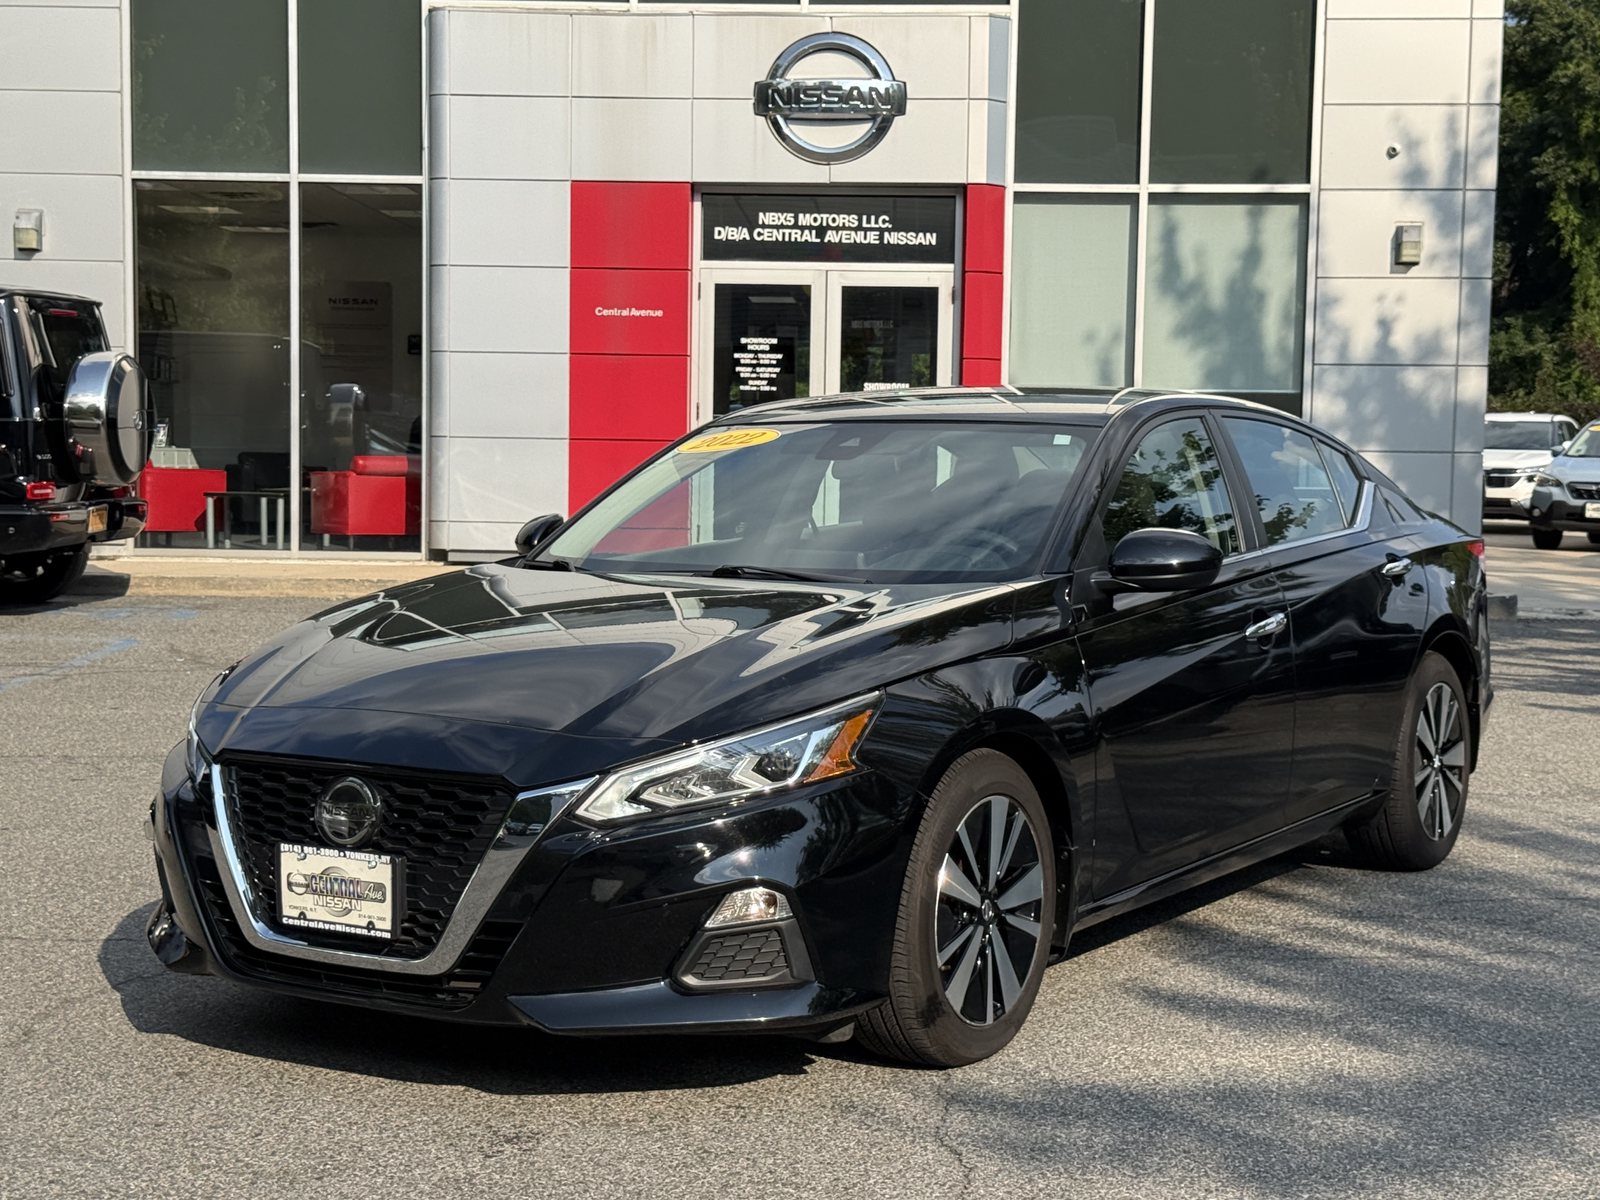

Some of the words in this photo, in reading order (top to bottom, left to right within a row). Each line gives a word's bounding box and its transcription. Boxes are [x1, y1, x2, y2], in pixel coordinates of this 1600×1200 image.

[767, 84, 892, 109] NISSAN
[757, 212, 795, 226] NBX5
[798, 213, 859, 229] MOTORS
[862, 215, 893, 229] LLC.
[713, 226, 750, 241] D/B/A
[753, 228, 821, 243] CENTRAL
[824, 230, 880, 245] AVENUE
[883, 232, 937, 246] NISSAN
[327, 297, 379, 306] NISSAN
[594, 306, 629, 316] Central
[630, 307, 664, 317] Avenue
[686, 432, 767, 451] 2022
[322, 804, 370, 817] NISSAN
[310, 873, 361, 899] CENTRAL
[363, 882, 385, 901] Ave.
[313, 894, 362, 912] NISSAN
[281, 916, 392, 939] CentralAveNissan.com
